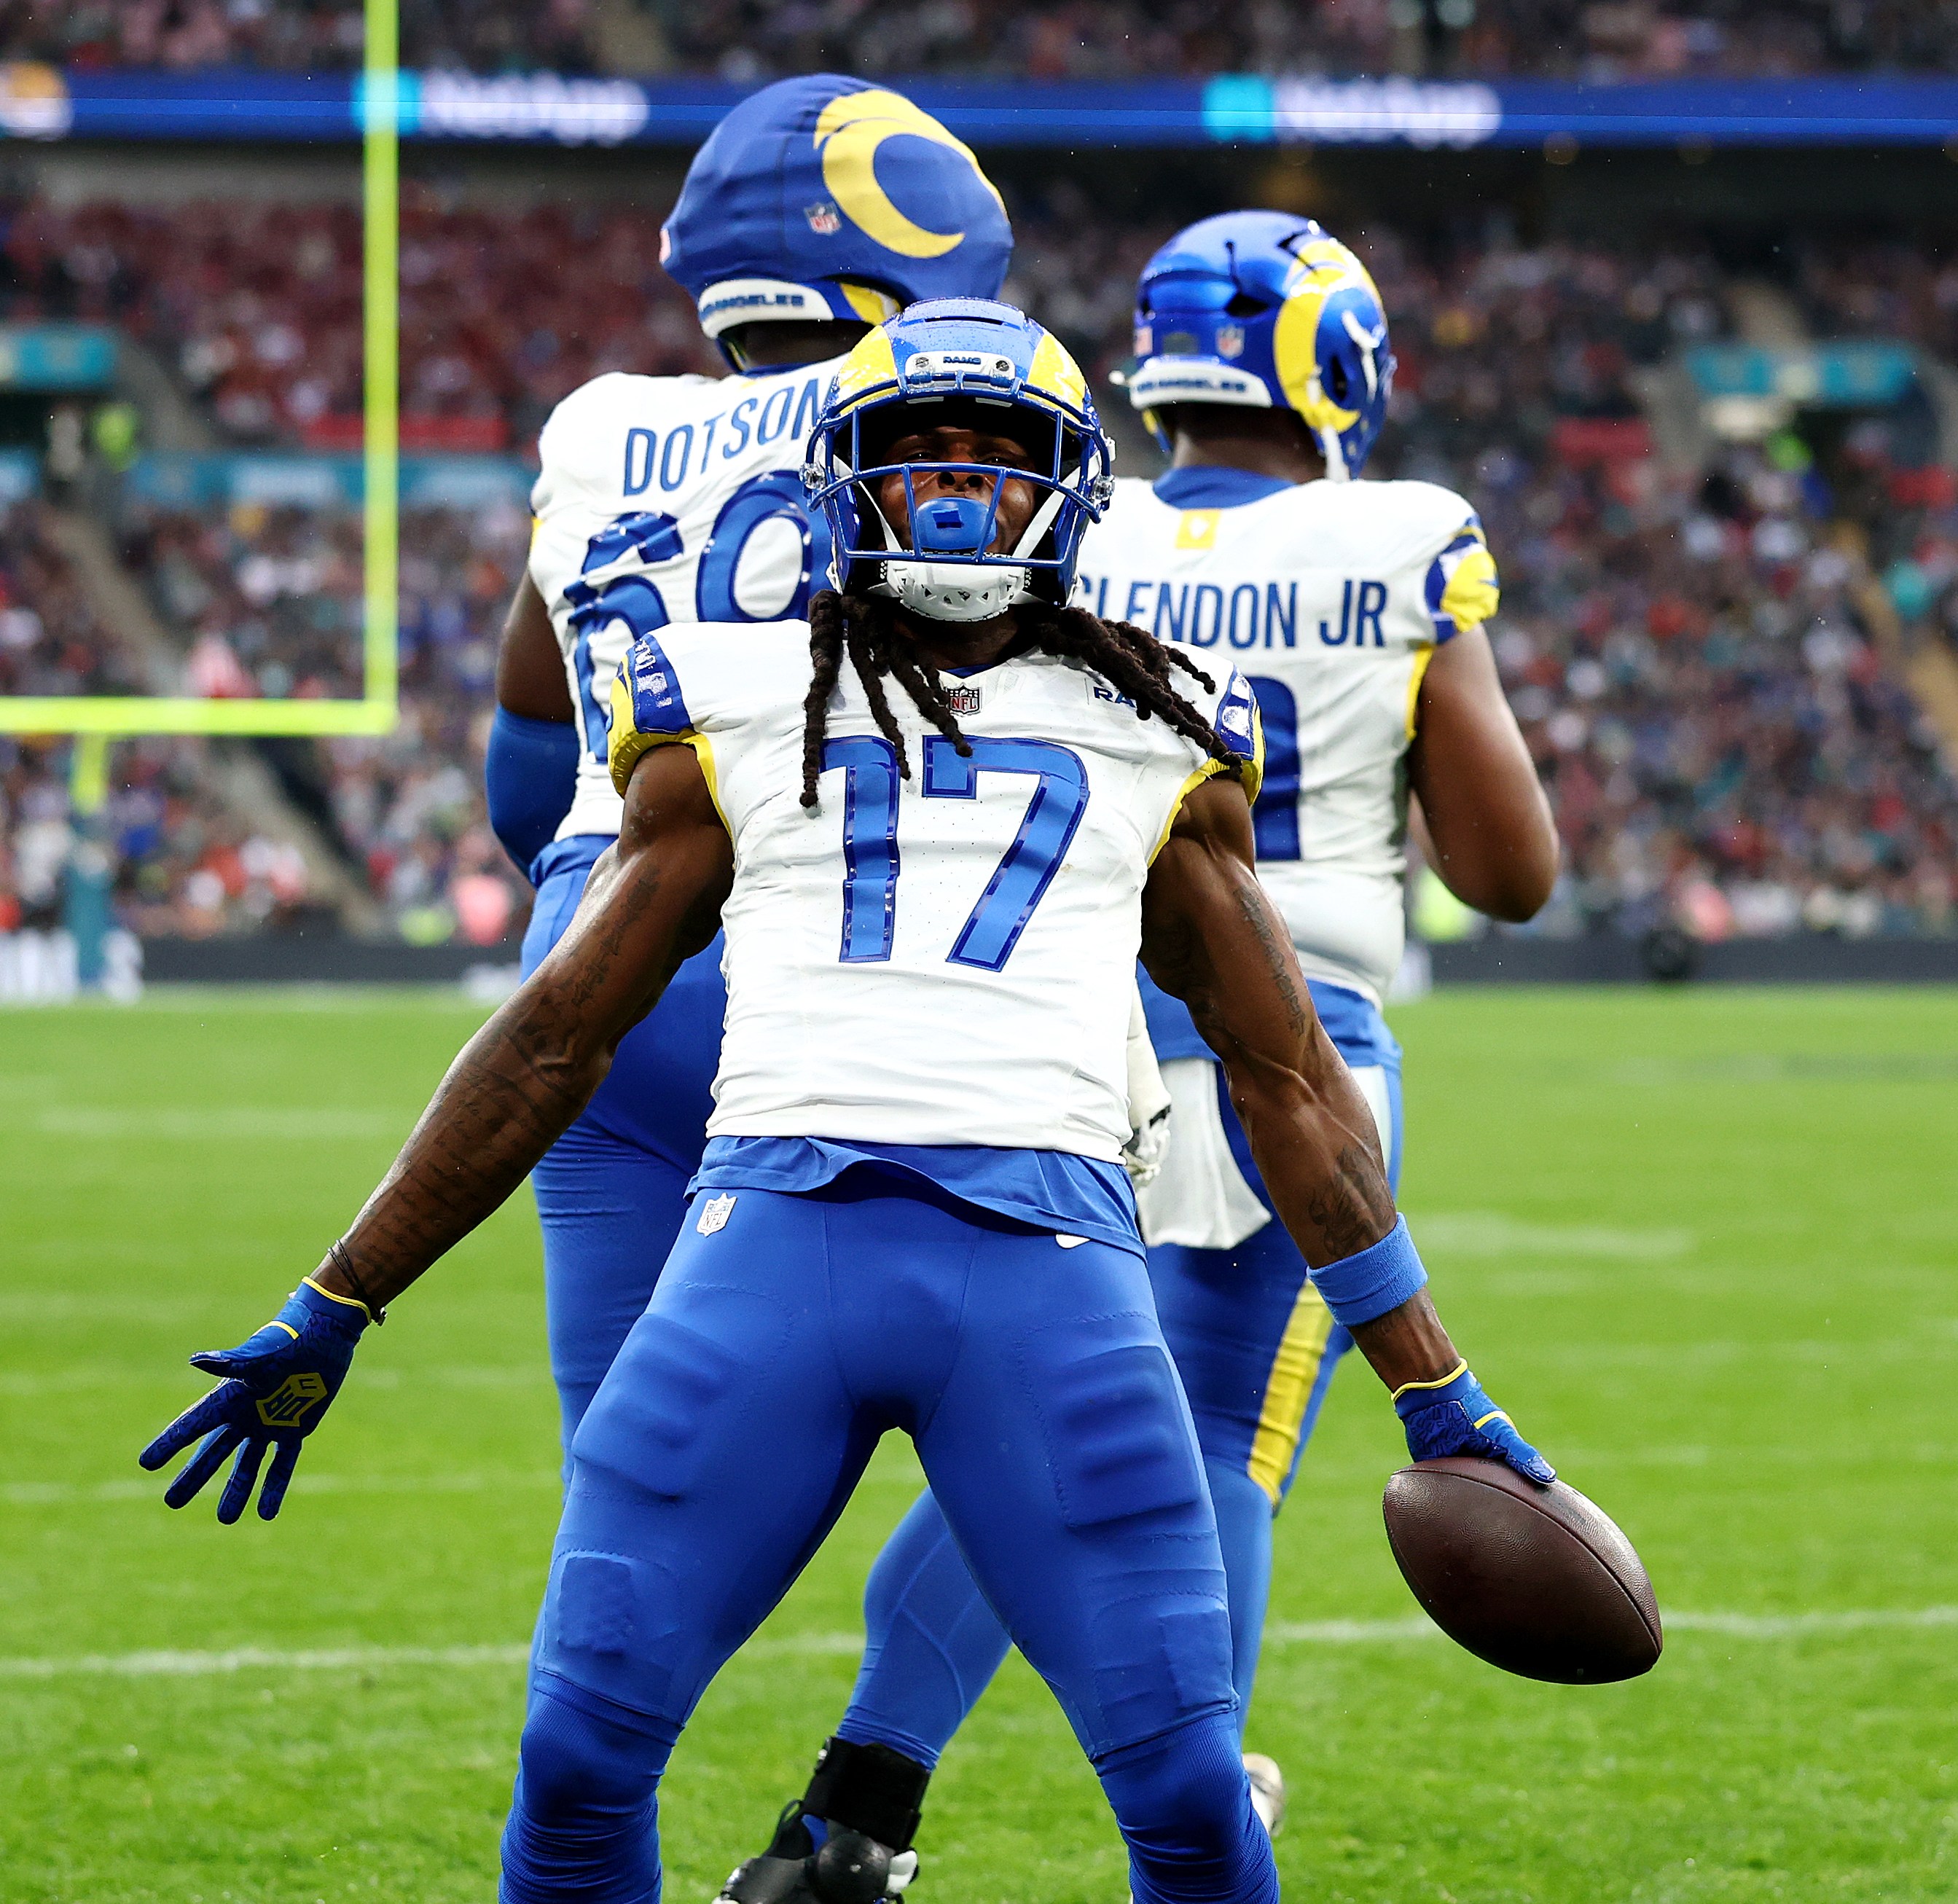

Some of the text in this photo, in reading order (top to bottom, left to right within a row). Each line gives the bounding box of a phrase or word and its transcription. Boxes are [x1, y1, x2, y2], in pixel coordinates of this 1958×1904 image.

[1080, 575, 1388, 651] LENDON JR
[951, 697, 977, 711] NFL
[818, 734, 1091, 973] 17
[702, 1212, 724, 1229] NFL
